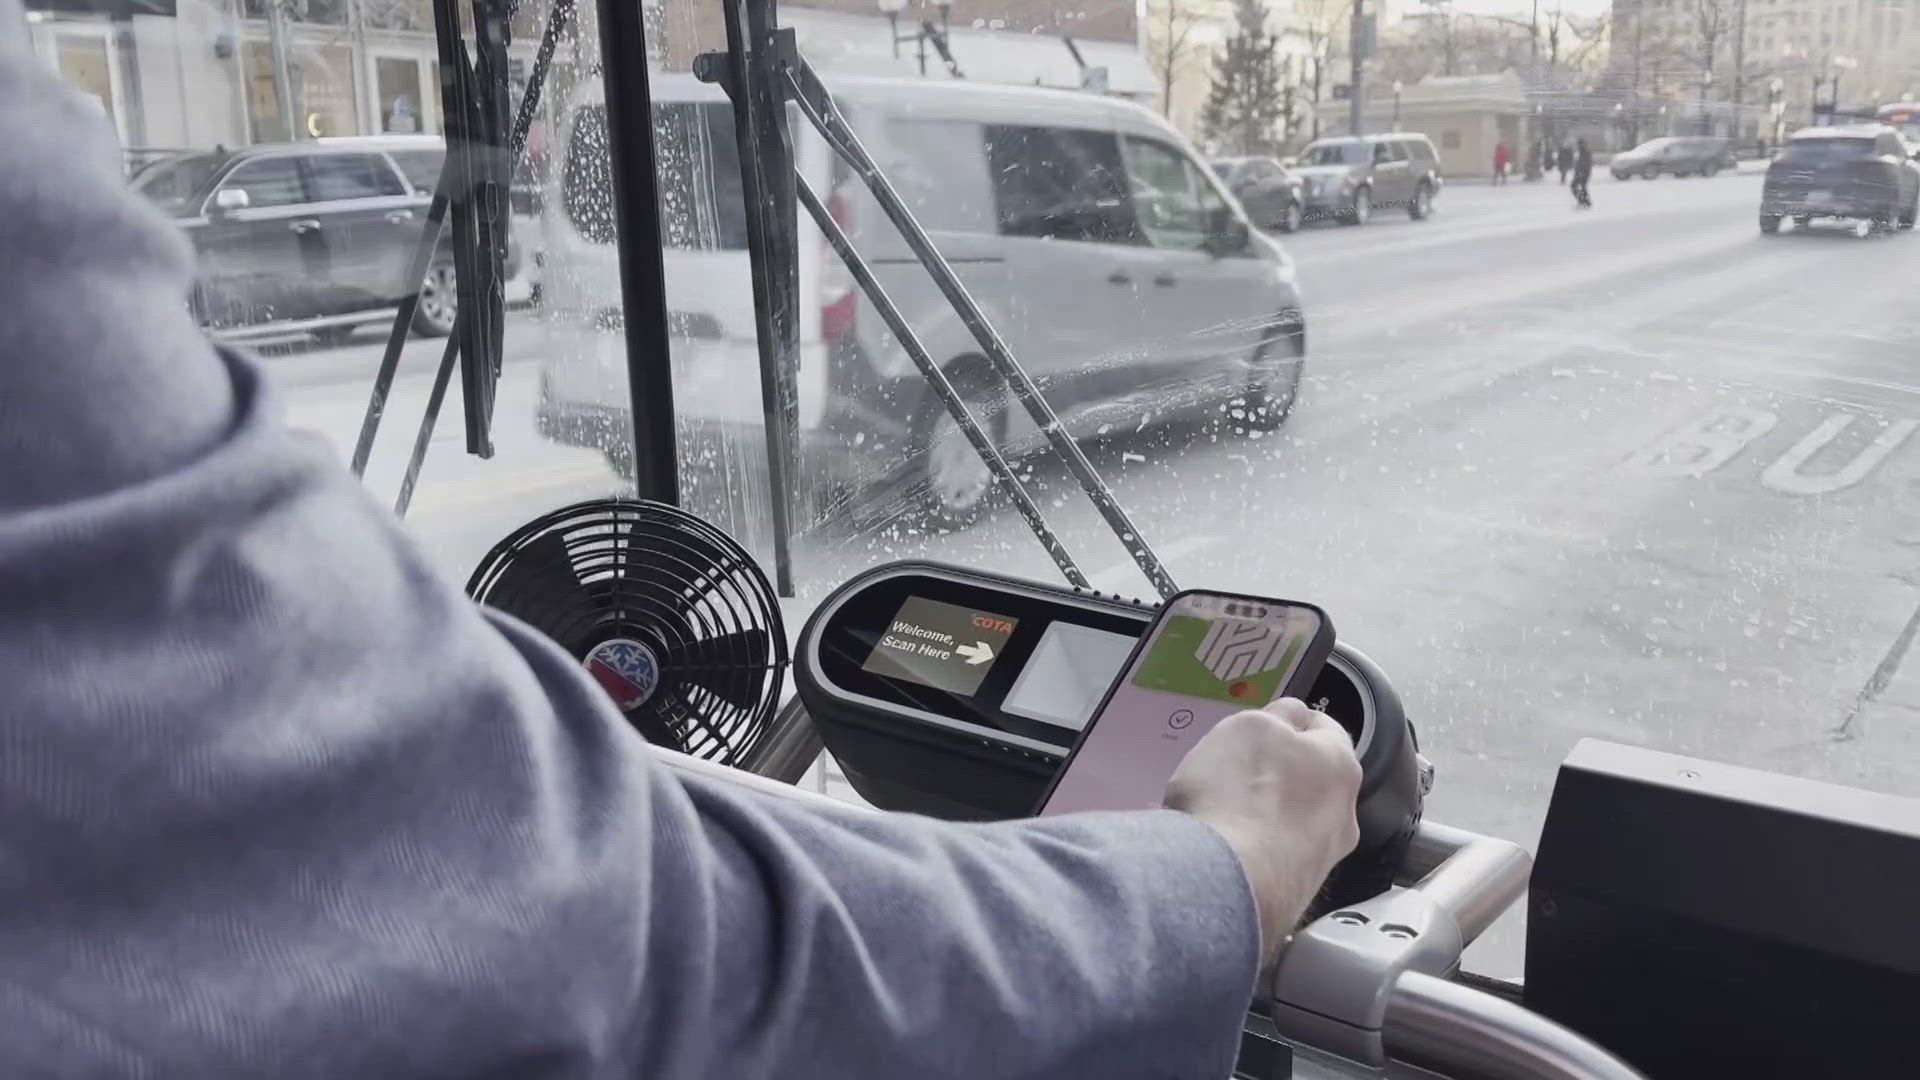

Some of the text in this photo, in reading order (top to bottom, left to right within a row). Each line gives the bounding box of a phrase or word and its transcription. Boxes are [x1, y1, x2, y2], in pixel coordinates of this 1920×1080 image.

[1606, 408, 1919, 495] BU
[892, 620, 954, 646] Welcome,
[971, 614, 1013, 634] COTA
[882, 635, 951, 660] Scan Here
